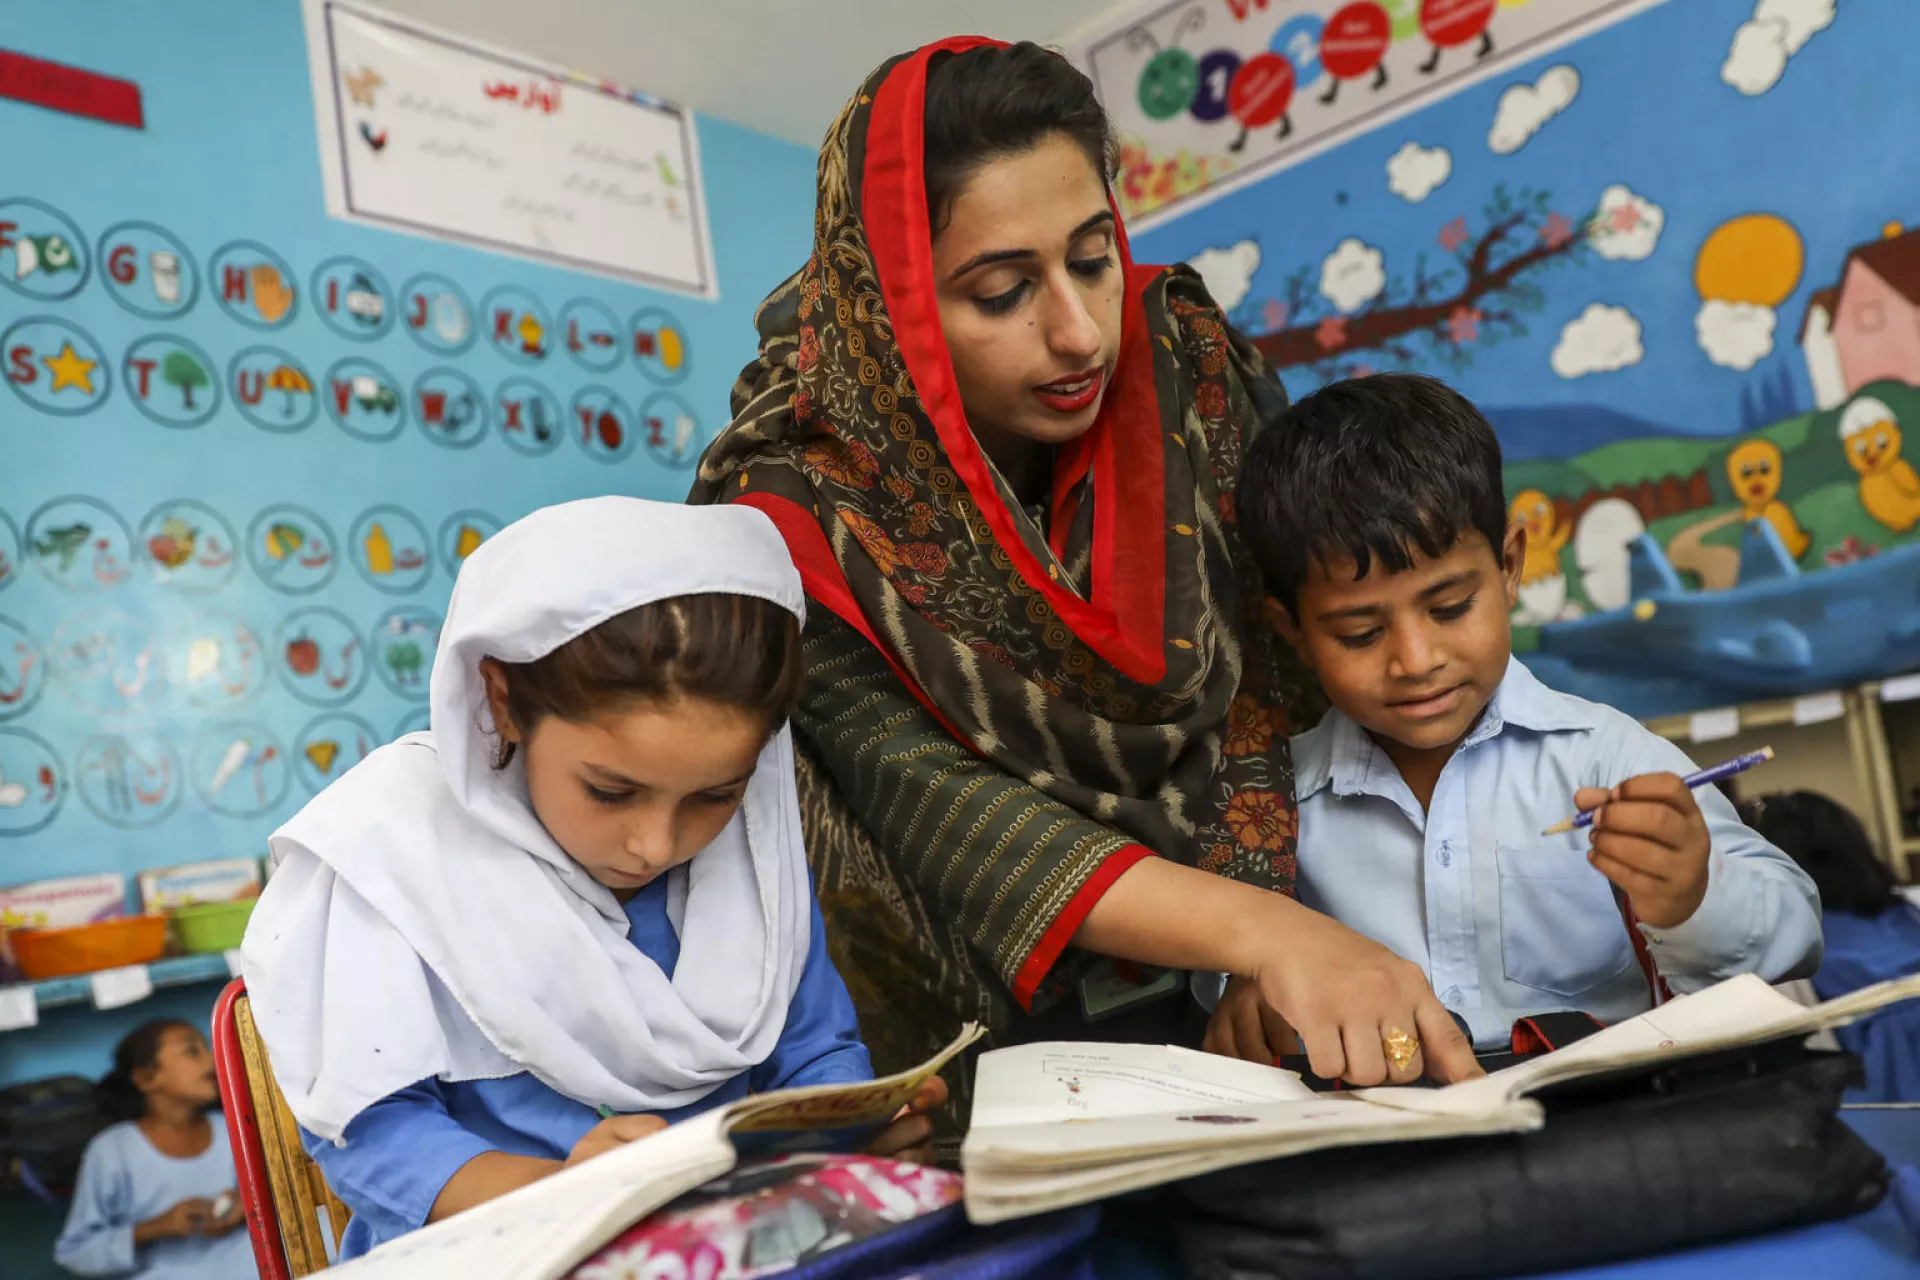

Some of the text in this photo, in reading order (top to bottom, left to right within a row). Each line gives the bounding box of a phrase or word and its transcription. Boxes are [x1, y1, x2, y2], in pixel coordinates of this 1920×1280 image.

[1287, 32, 1317, 66] 2
[1206, 66, 1227, 102] 1
[108, 245, 137, 285] G
[222, 265, 246, 303] H
[328, 280, 338, 312] I
[408, 294, 427, 328] J
[494, 308, 513, 344] K
[568, 319, 583, 352] L
[9, 346, 37, 384] S
[129, 359, 158, 398] T
[238, 371, 264, 405] U
[332, 379, 352, 416] V
[502, 400, 523, 431] X
[576, 404, 593, 444] Y
[644, 417, 666, 447] Z
